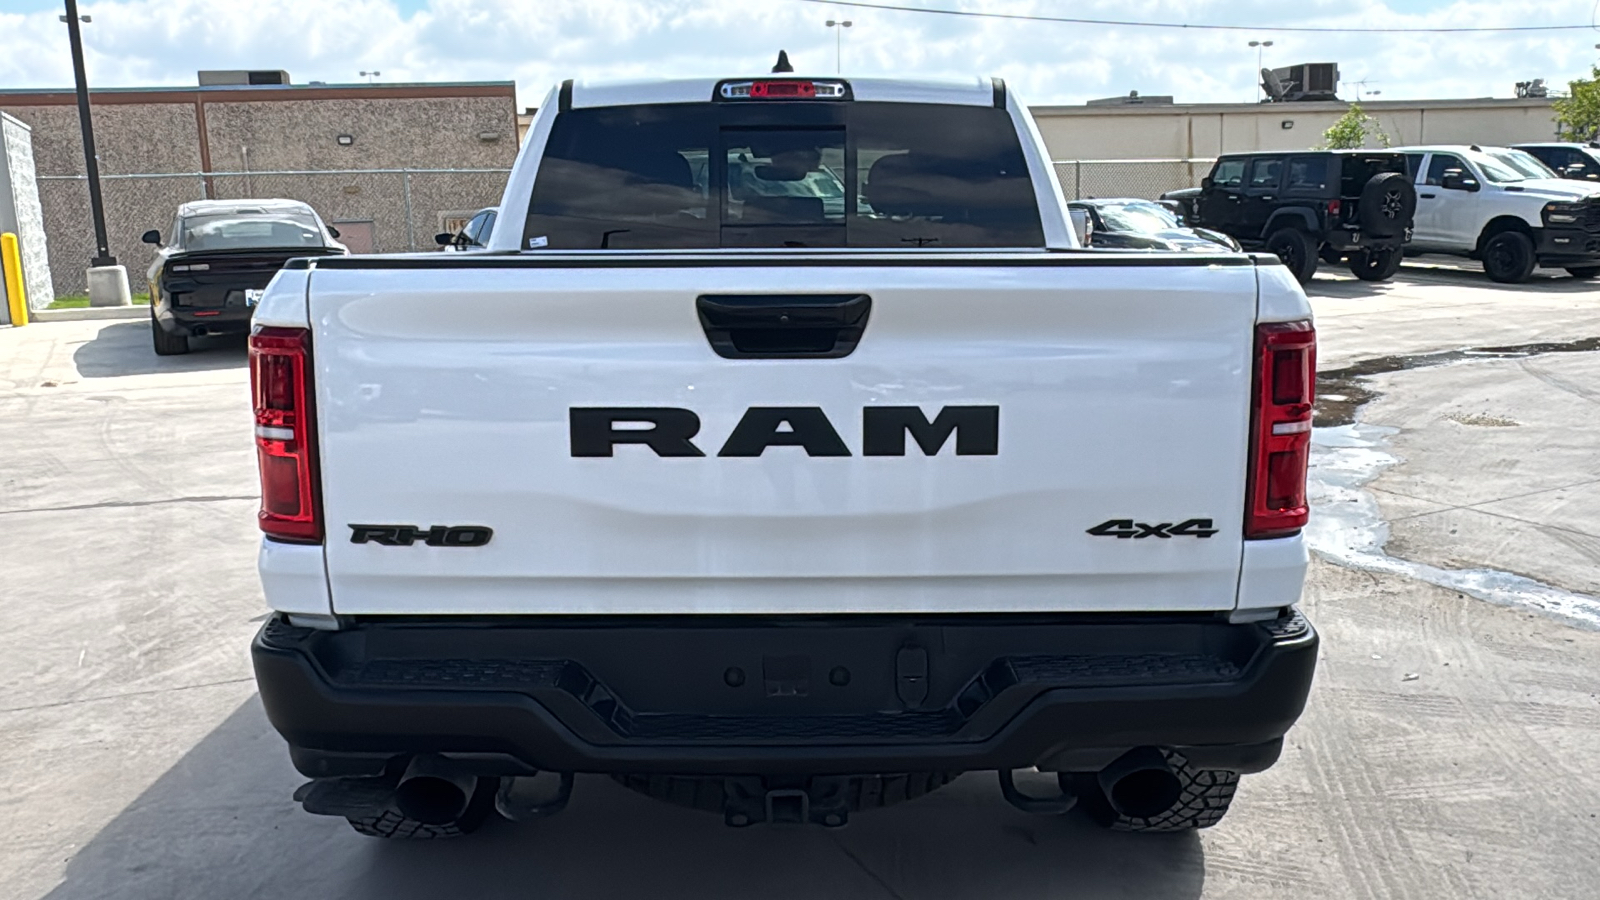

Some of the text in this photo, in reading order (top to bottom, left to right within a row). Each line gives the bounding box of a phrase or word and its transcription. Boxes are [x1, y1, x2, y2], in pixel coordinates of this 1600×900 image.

[569, 405, 1000, 458] RAM
[347, 523, 494, 547] RHO
[1086, 518, 1219, 539] 4x4
